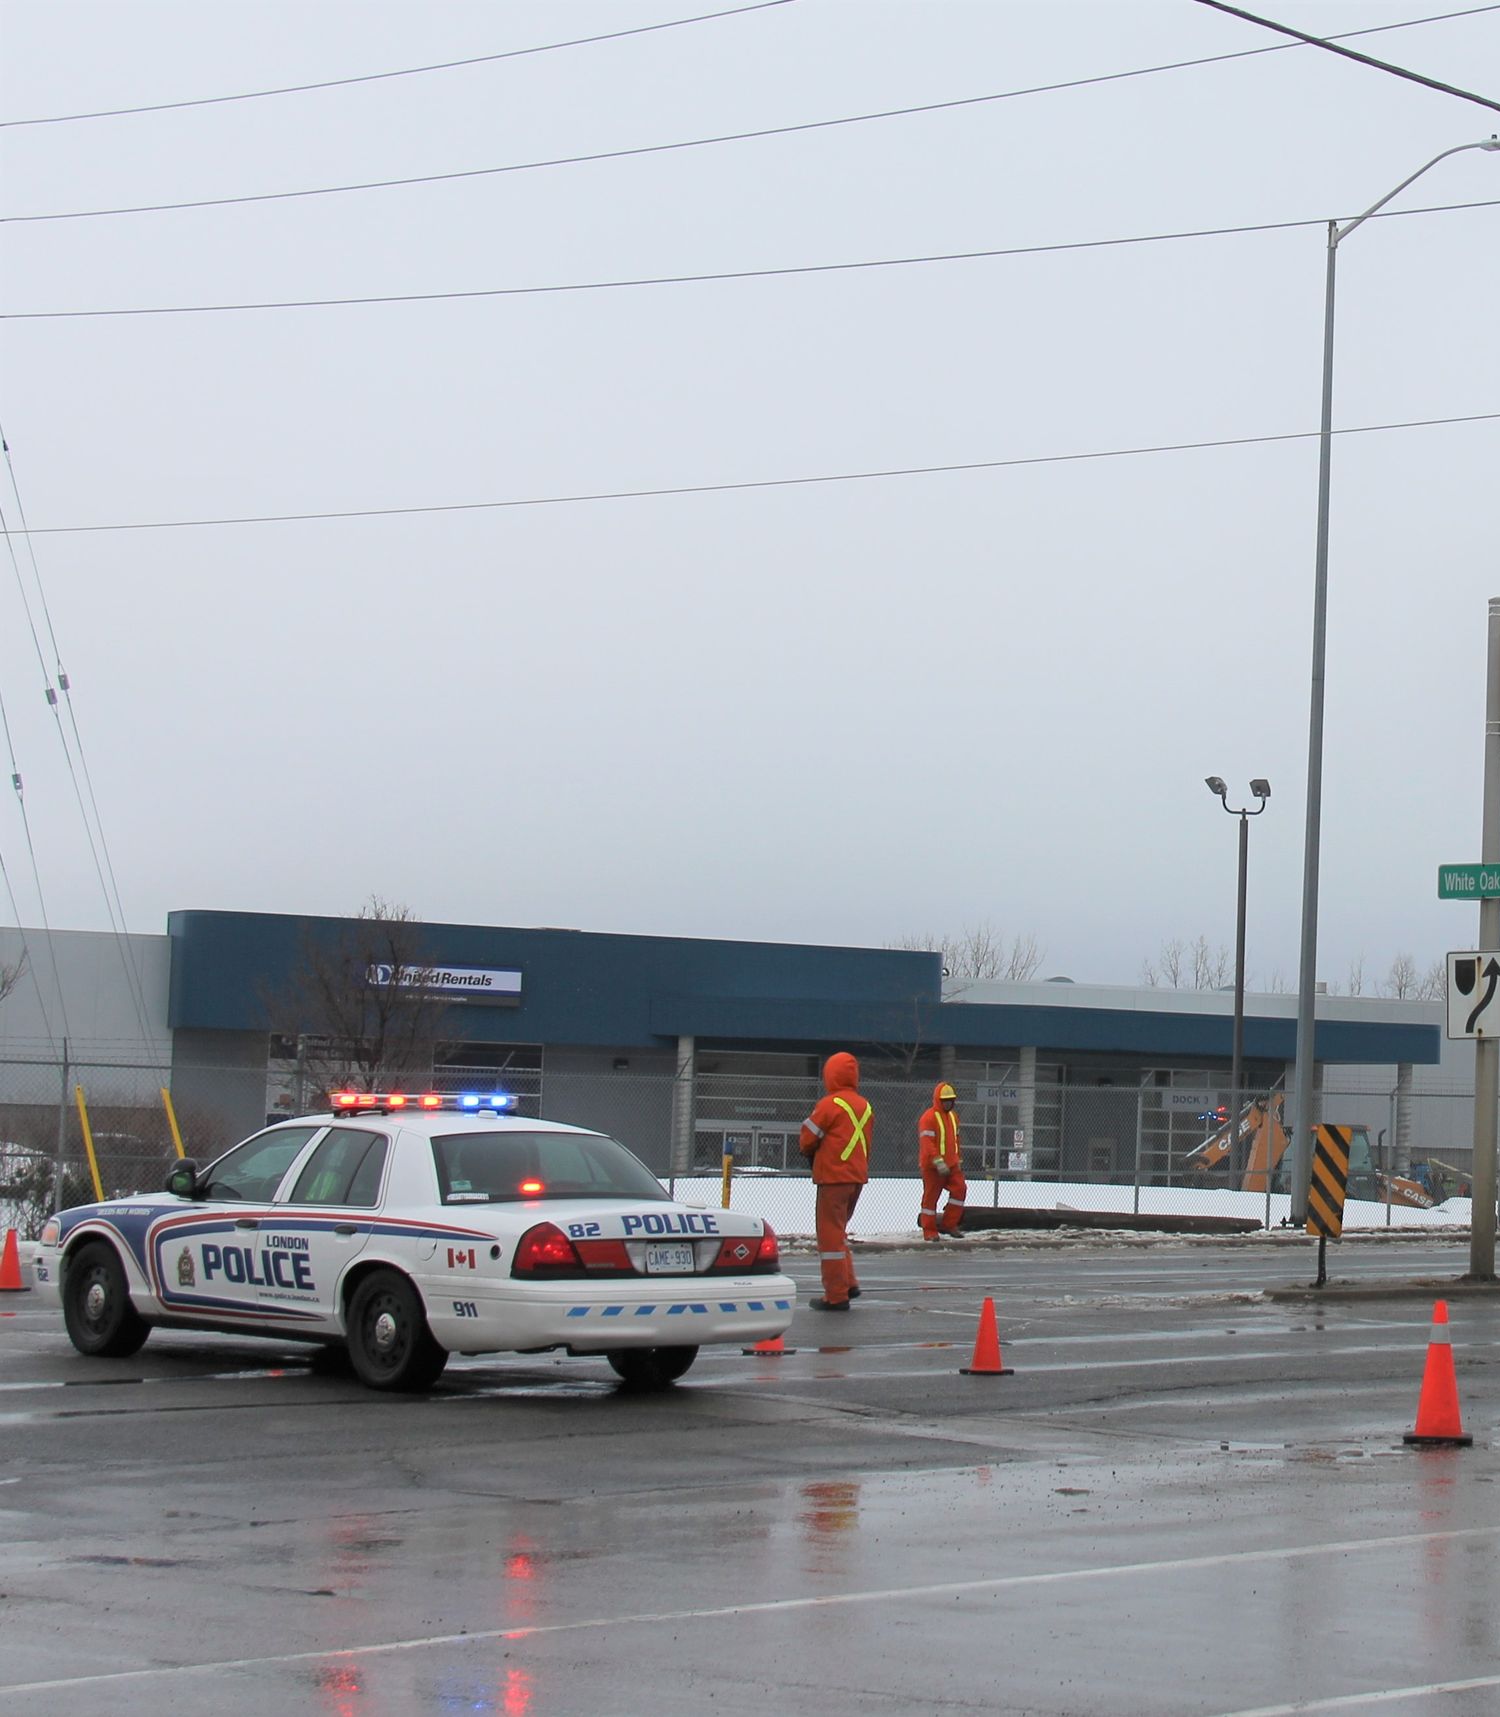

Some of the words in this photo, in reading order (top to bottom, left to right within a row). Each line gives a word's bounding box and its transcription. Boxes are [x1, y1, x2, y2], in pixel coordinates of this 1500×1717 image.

[1444, 872, 1475, 891] White
[1480, 871, 1500, 890] Oak
[441, 972, 493, 987] Rentals
[1403, 1188, 1434, 1208] CASE
[568, 1222, 602, 1238] 82
[621, 1213, 721, 1236] POLICE
[266, 1234, 309, 1250] LONDON
[201, 1243, 316, 1291] POLICE
[452, 1300, 478, 1318] 911
